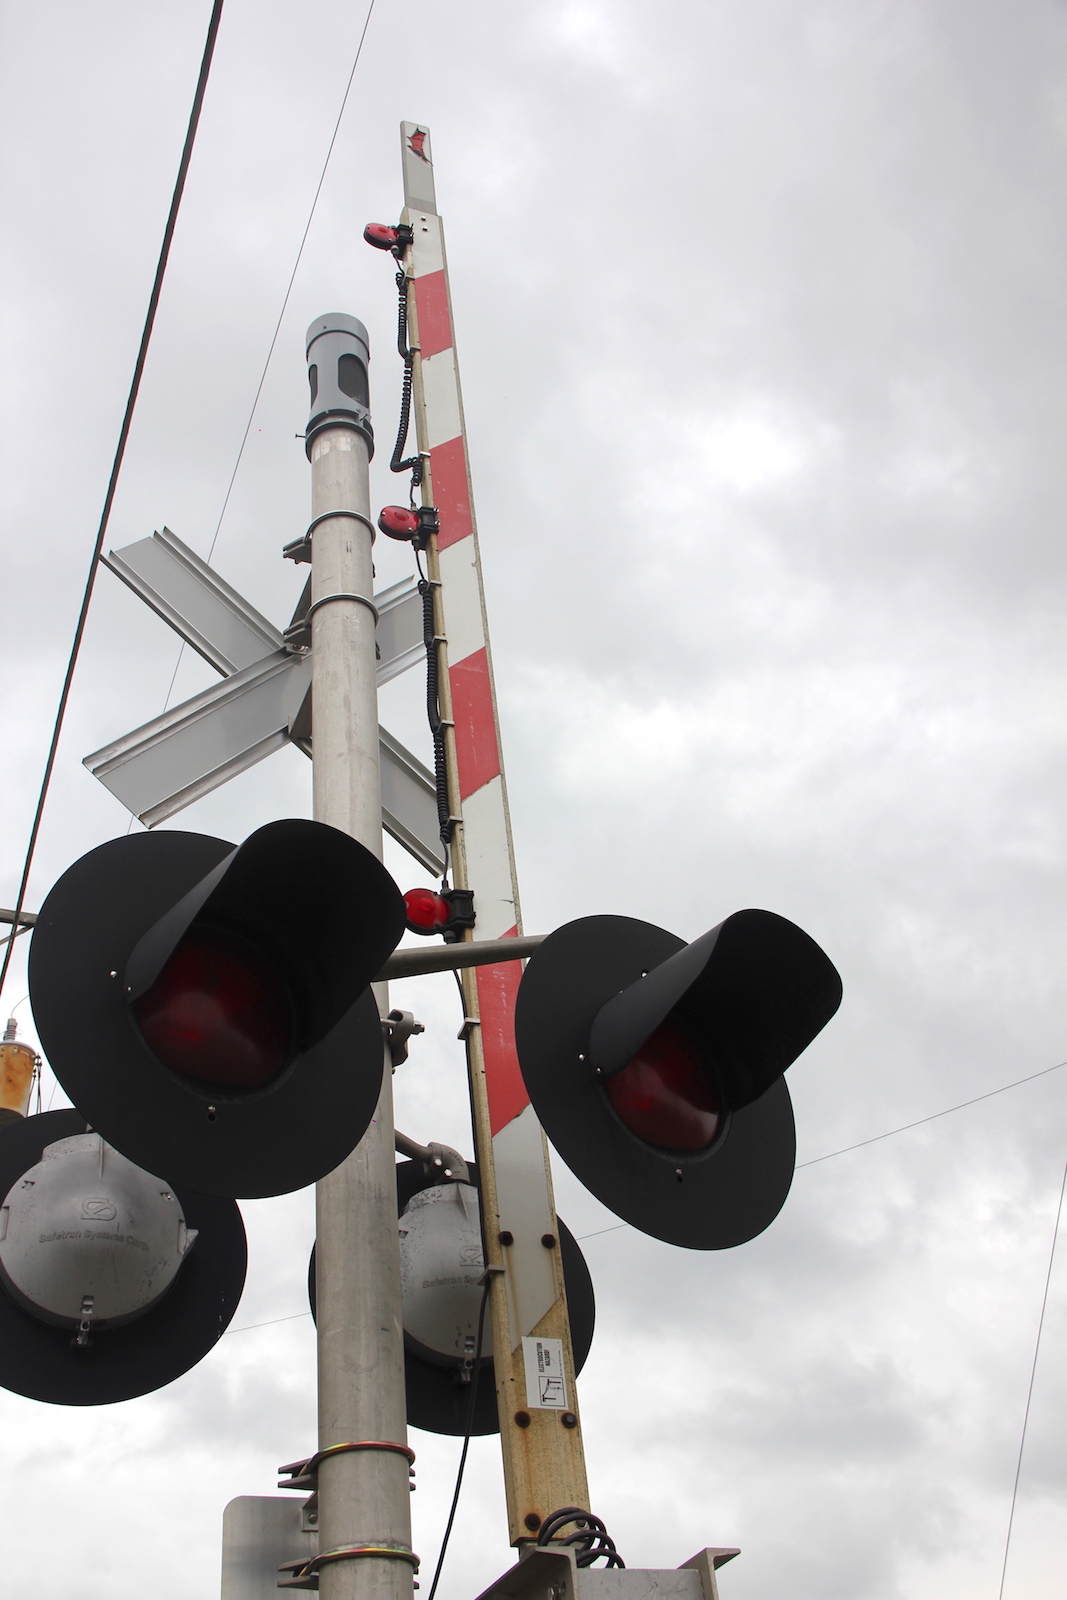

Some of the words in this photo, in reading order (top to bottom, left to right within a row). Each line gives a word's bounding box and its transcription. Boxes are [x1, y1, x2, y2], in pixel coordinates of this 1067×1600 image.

[38, 1230, 81, 1243] Safetran
[84, 1229, 125, 1243] Systems
[422, 1276, 462, 1289] Safetran
[537, 1342, 545, 1373] ELECTROCUTION
